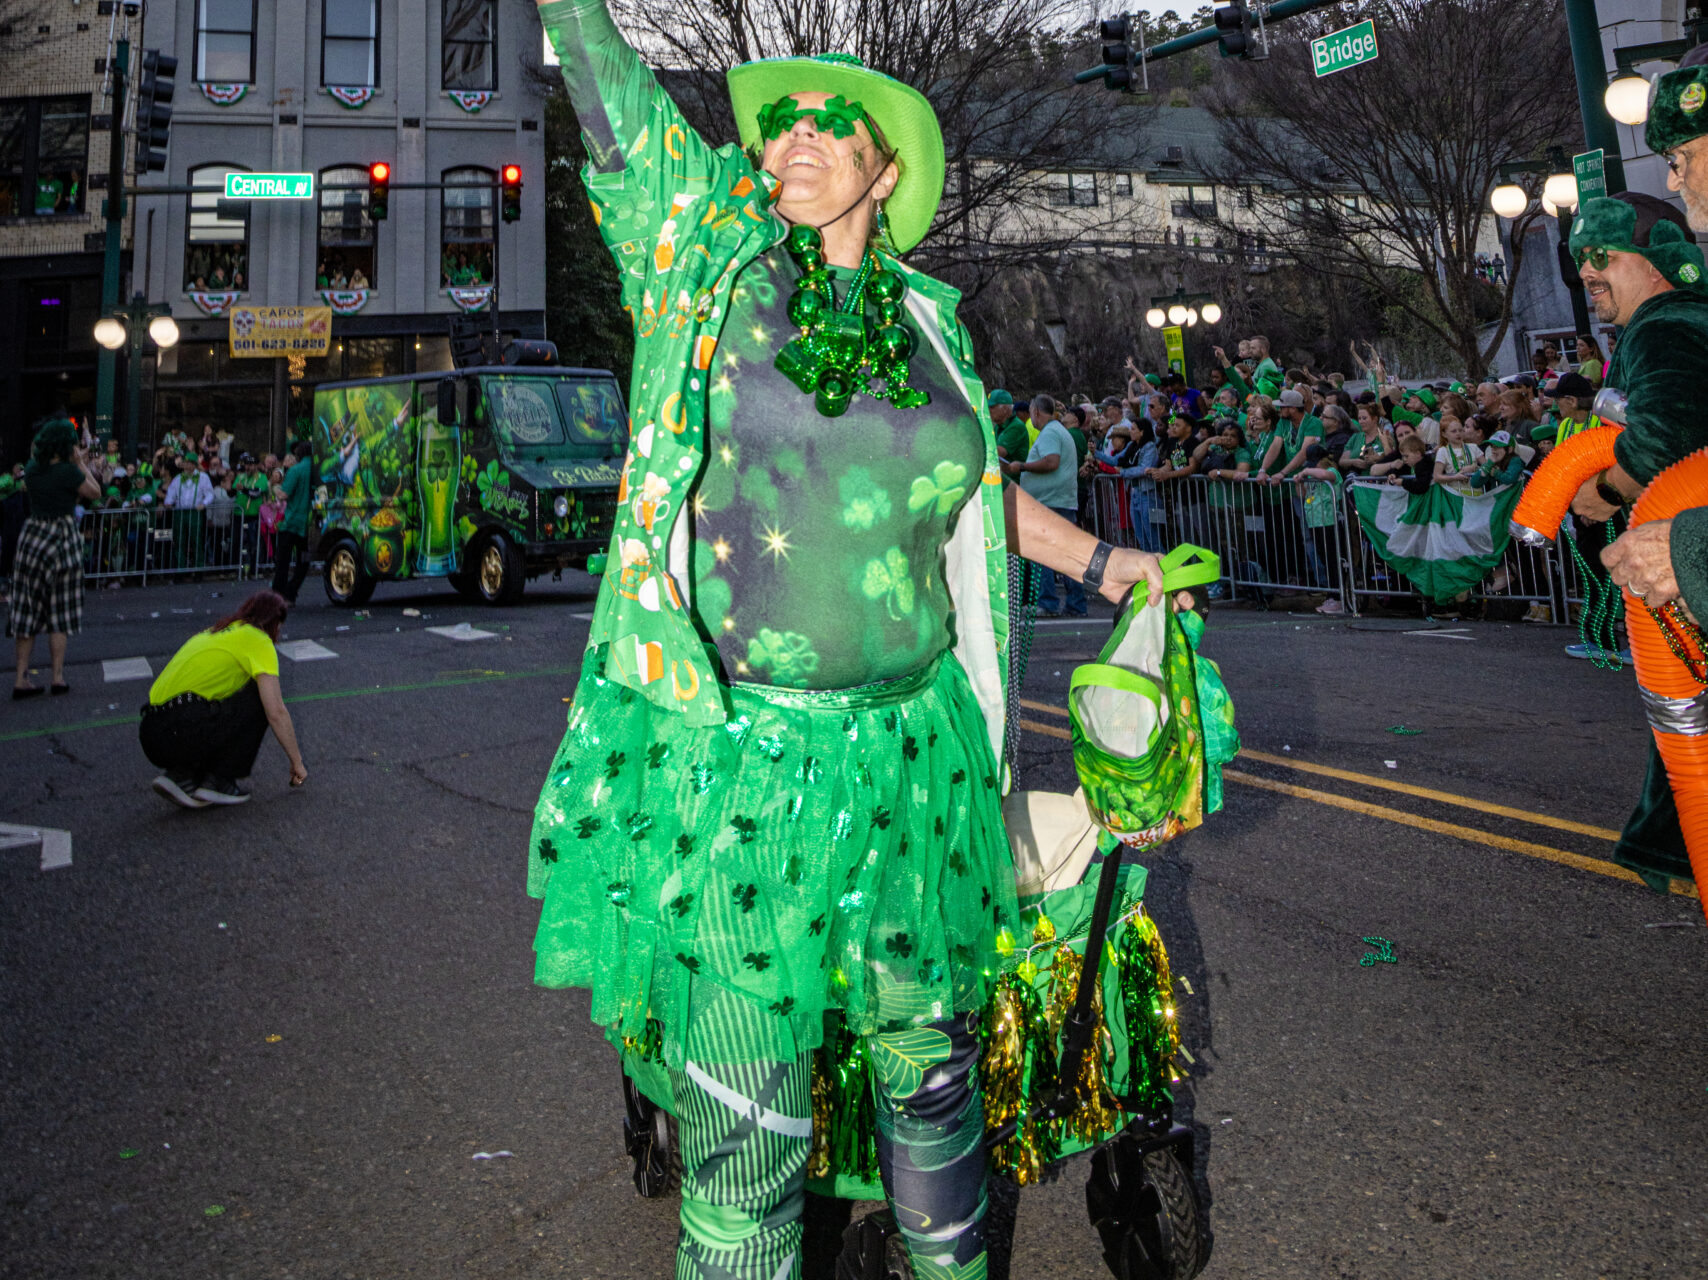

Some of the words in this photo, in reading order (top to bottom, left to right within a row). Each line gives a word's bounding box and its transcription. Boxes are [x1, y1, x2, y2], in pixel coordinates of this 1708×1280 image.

[1314, 34, 1375, 69] Bridge
[231, 176, 291, 195] CENTRAL
[294, 182, 308, 195] AV
[262, 319, 303, 329] TACOS
